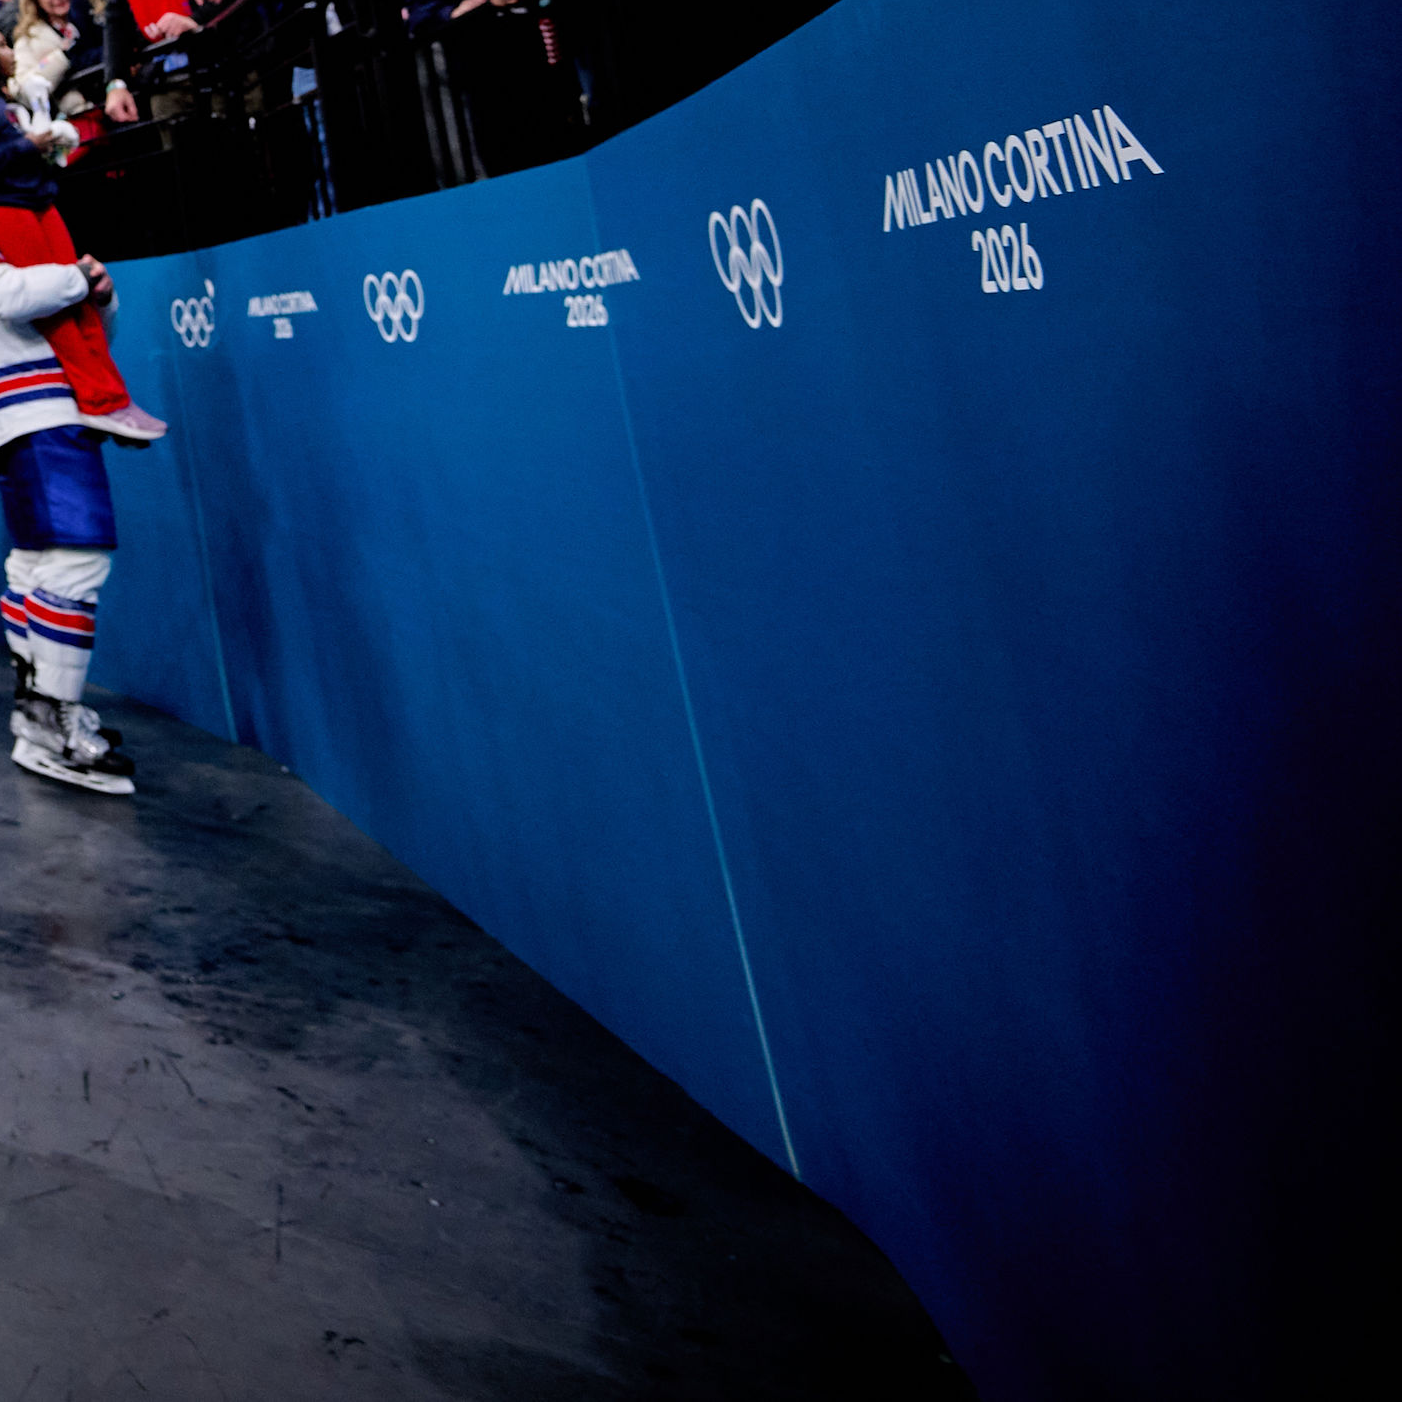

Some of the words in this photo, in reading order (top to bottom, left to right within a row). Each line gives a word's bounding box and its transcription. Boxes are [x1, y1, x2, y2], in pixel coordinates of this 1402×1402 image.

[882, 149, 986, 233] MILANO
[983, 105, 1166, 208] CORTINA
[502, 258, 580, 296] MILANO
[578, 248, 642, 289] CORTINA
[971, 222, 1045, 294] 2026
[563, 293, 610, 328] 2026
